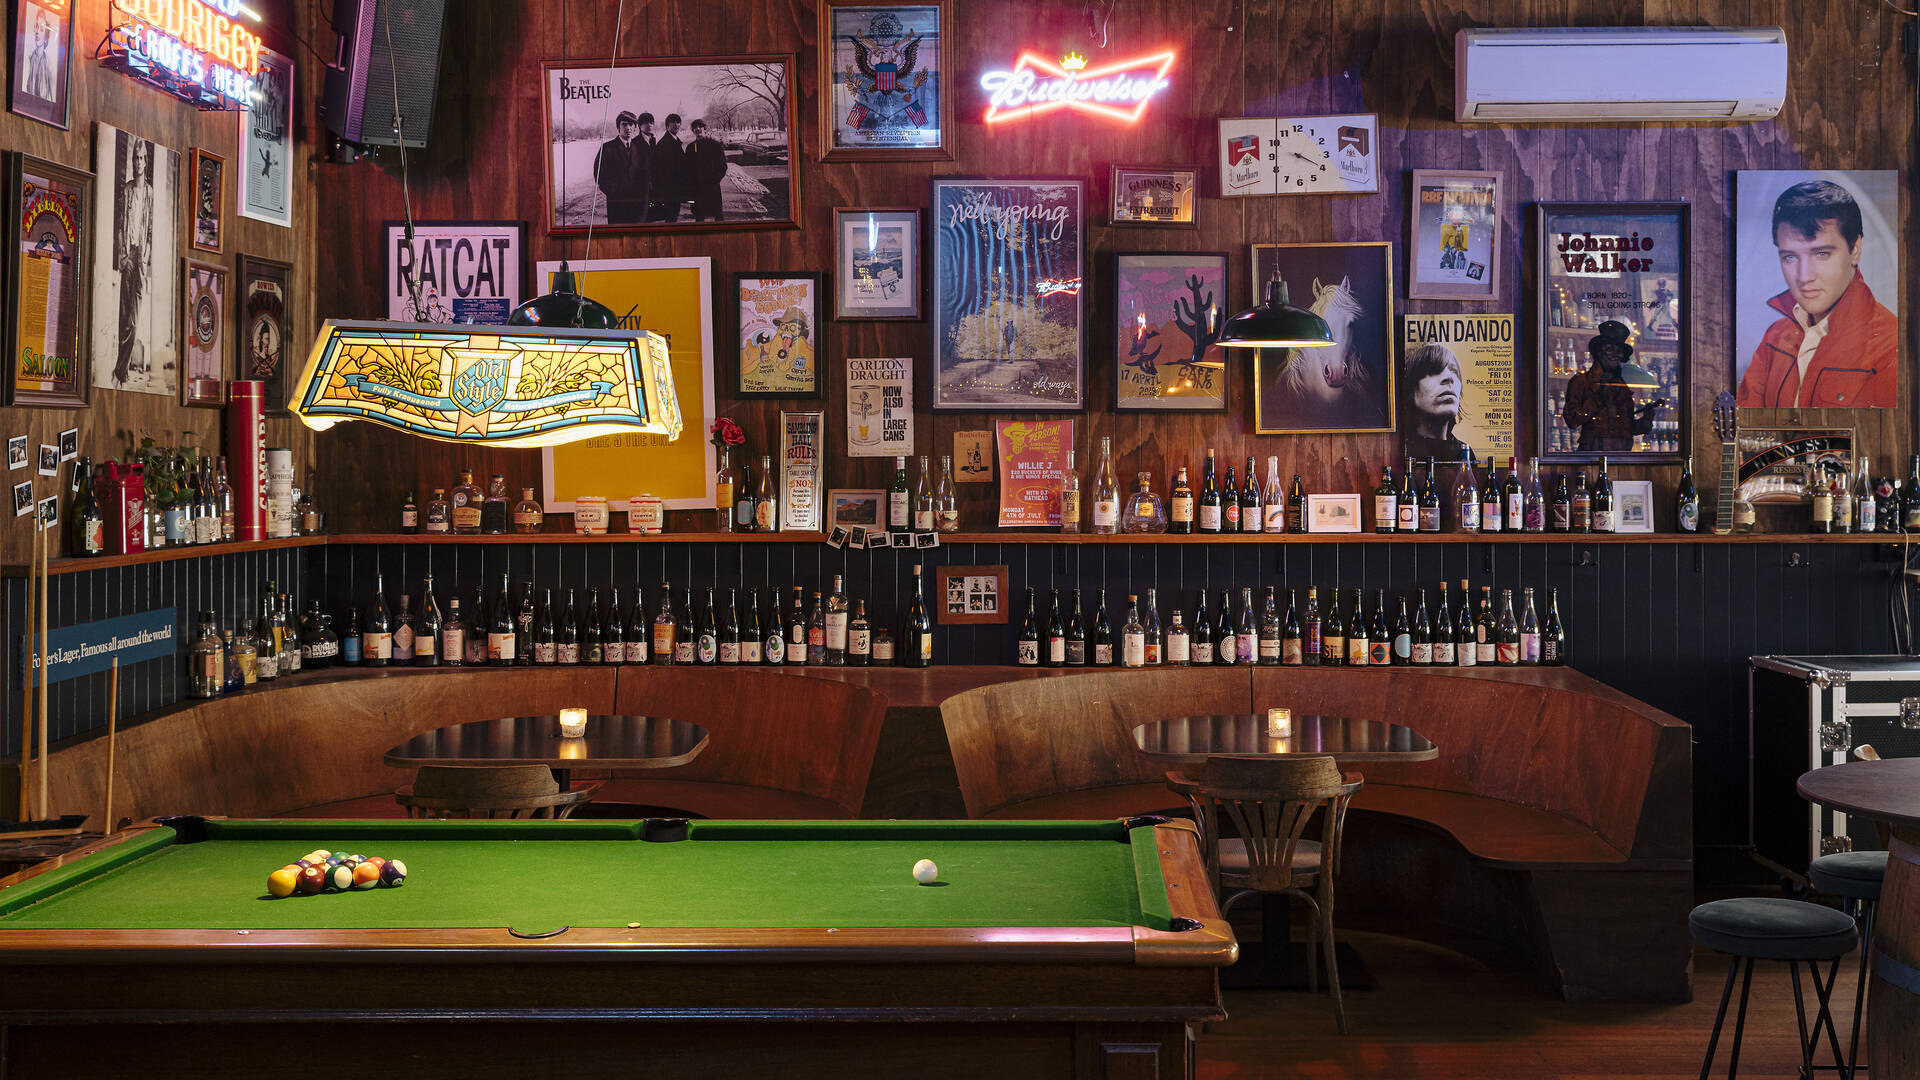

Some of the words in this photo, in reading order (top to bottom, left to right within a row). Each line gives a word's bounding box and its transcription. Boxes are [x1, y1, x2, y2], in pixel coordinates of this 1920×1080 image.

[560, 77, 611, 103] BEATLES
[980, 69, 1169, 106] Budweiser
[1292, 125, 1303, 133] 12
[1323, 151, 1330, 159] 3
[1236, 168, 1258, 182] Marlboro
[1128, 179, 1182, 192] GUINNESS
[948, 192, 992, 228] neil
[995, 203, 1069, 240] young
[1156, 207, 1179, 215] STOUT
[1557, 232, 1654, 251] Johnnie
[397, 238, 510, 297] RATCAT
[1561, 253, 1653, 273] Walker
[1407, 320, 1450, 342] EVAN
[1454, 320, 1511, 342] DANDO
[22, 347, 69, 378] SALOON
[850, 360, 904, 370] CARLTON
[850, 371, 906, 380] DRAUGHT
[1121, 370, 1130, 380] 17
[1132, 372, 1162, 385] APRIL
[372, 385, 391, 396] Fully
[455, 373, 504, 407] Style
[883, 386, 902, 396] NOW
[883, 397, 903, 408] ALSO
[883, 409, 891, 419] IN
[883, 419, 907, 430] LARGE
[792, 435, 811, 446] HALL
[883, 431, 905, 441] CANS
[787, 446, 816, 459] RULES
[32, 652, 59, 668] Foer's
[58, 648, 81, 664] Lager,
[80, 643, 108, 657] Famous
[108, 636, 117, 651] all
[117, 630, 142, 650] around
[141, 630, 152, 643] the
[152, 624, 172, 639] world
